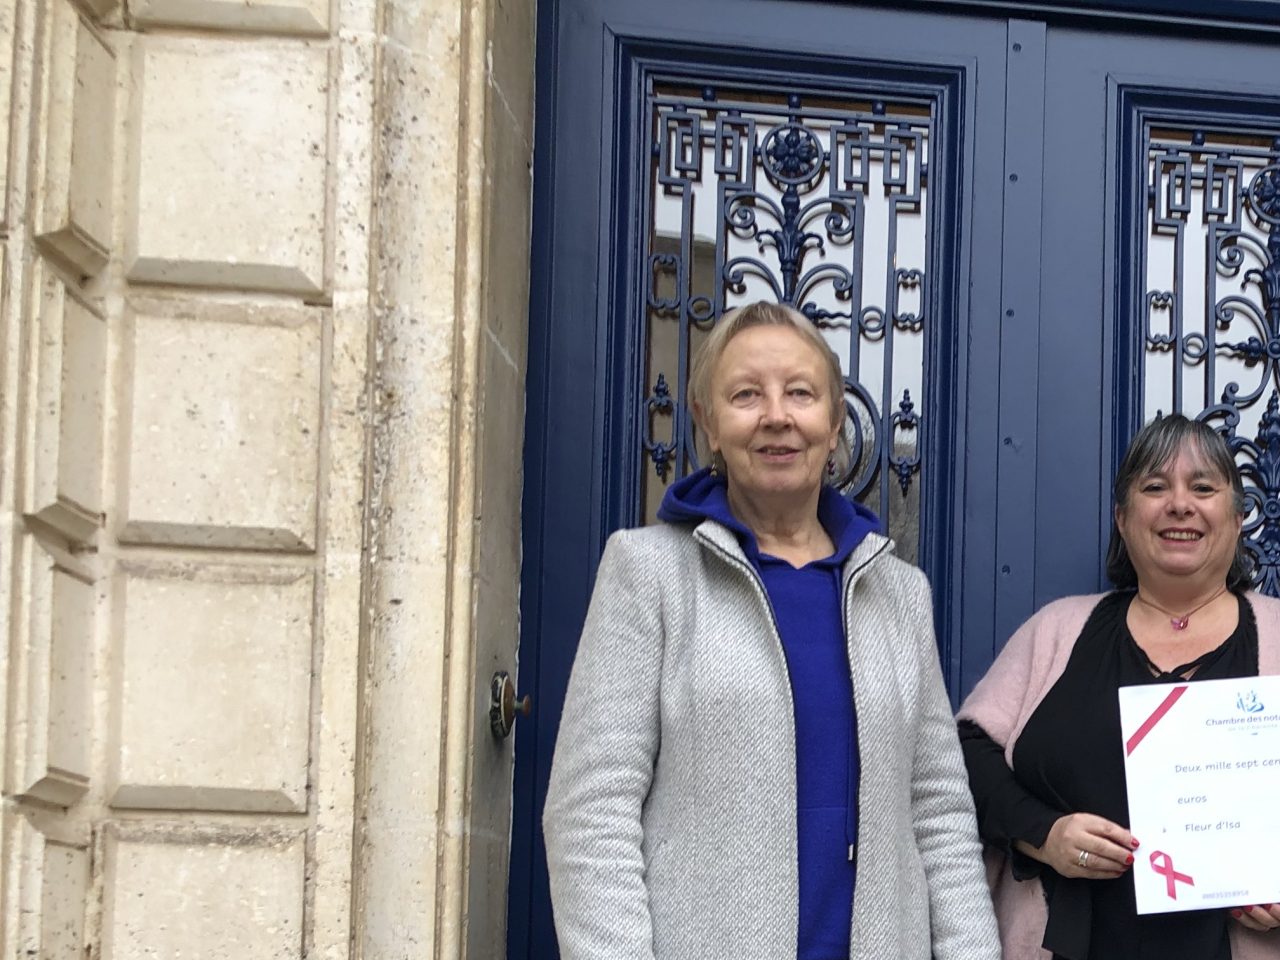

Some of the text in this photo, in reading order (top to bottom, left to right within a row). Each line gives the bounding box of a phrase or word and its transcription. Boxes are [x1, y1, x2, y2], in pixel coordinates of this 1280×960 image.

[1205, 716, 1246, 727] Chambre
[1246, 715, 1263, 724] des
[1174, 764, 1201, 774] Deux
[1205, 761, 1232, 771] mille
[1235, 759, 1259, 770] sept
[1177, 795, 1208, 805] euros
[1184, 822, 1212, 833] Fleur
[1216, 820, 1241, 831] d'Isa
